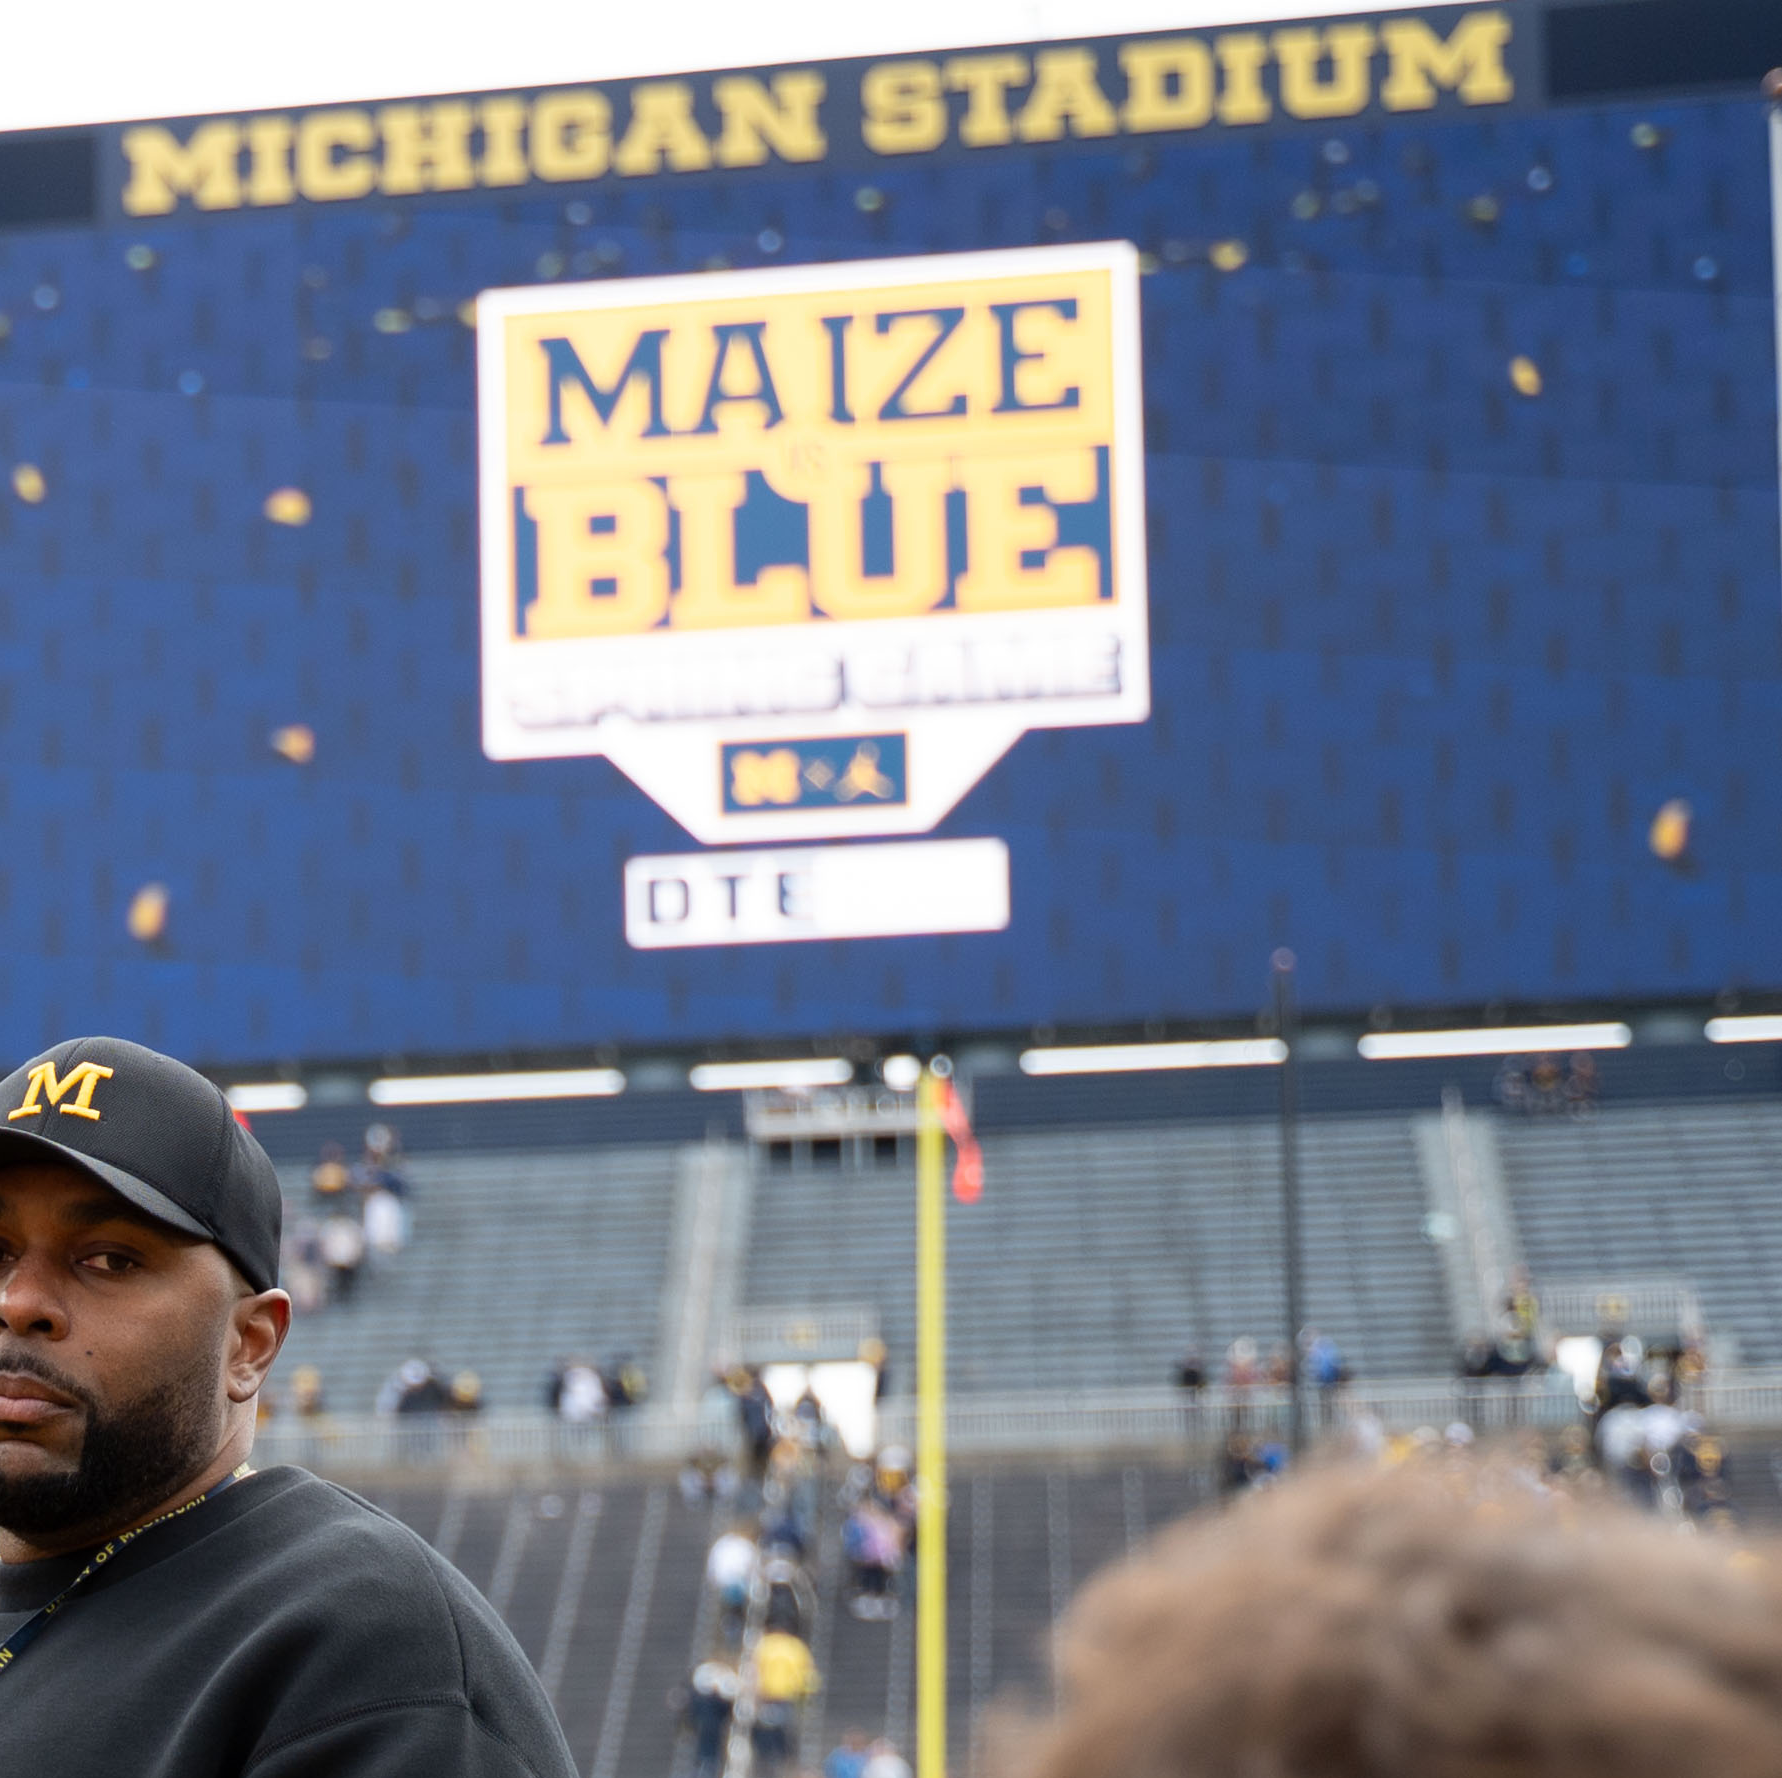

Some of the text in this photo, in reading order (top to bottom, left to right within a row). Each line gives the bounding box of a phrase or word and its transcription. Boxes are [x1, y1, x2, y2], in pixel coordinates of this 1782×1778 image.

[122, 12, 1513, 216] MICHIGAN STADIUM
[537, 298, 1080, 446] MAIZE
[523, 446, 1101, 636] BLUE
[648, 872, 814, 923] DTE
[7, 1061, 115, 1121] M
